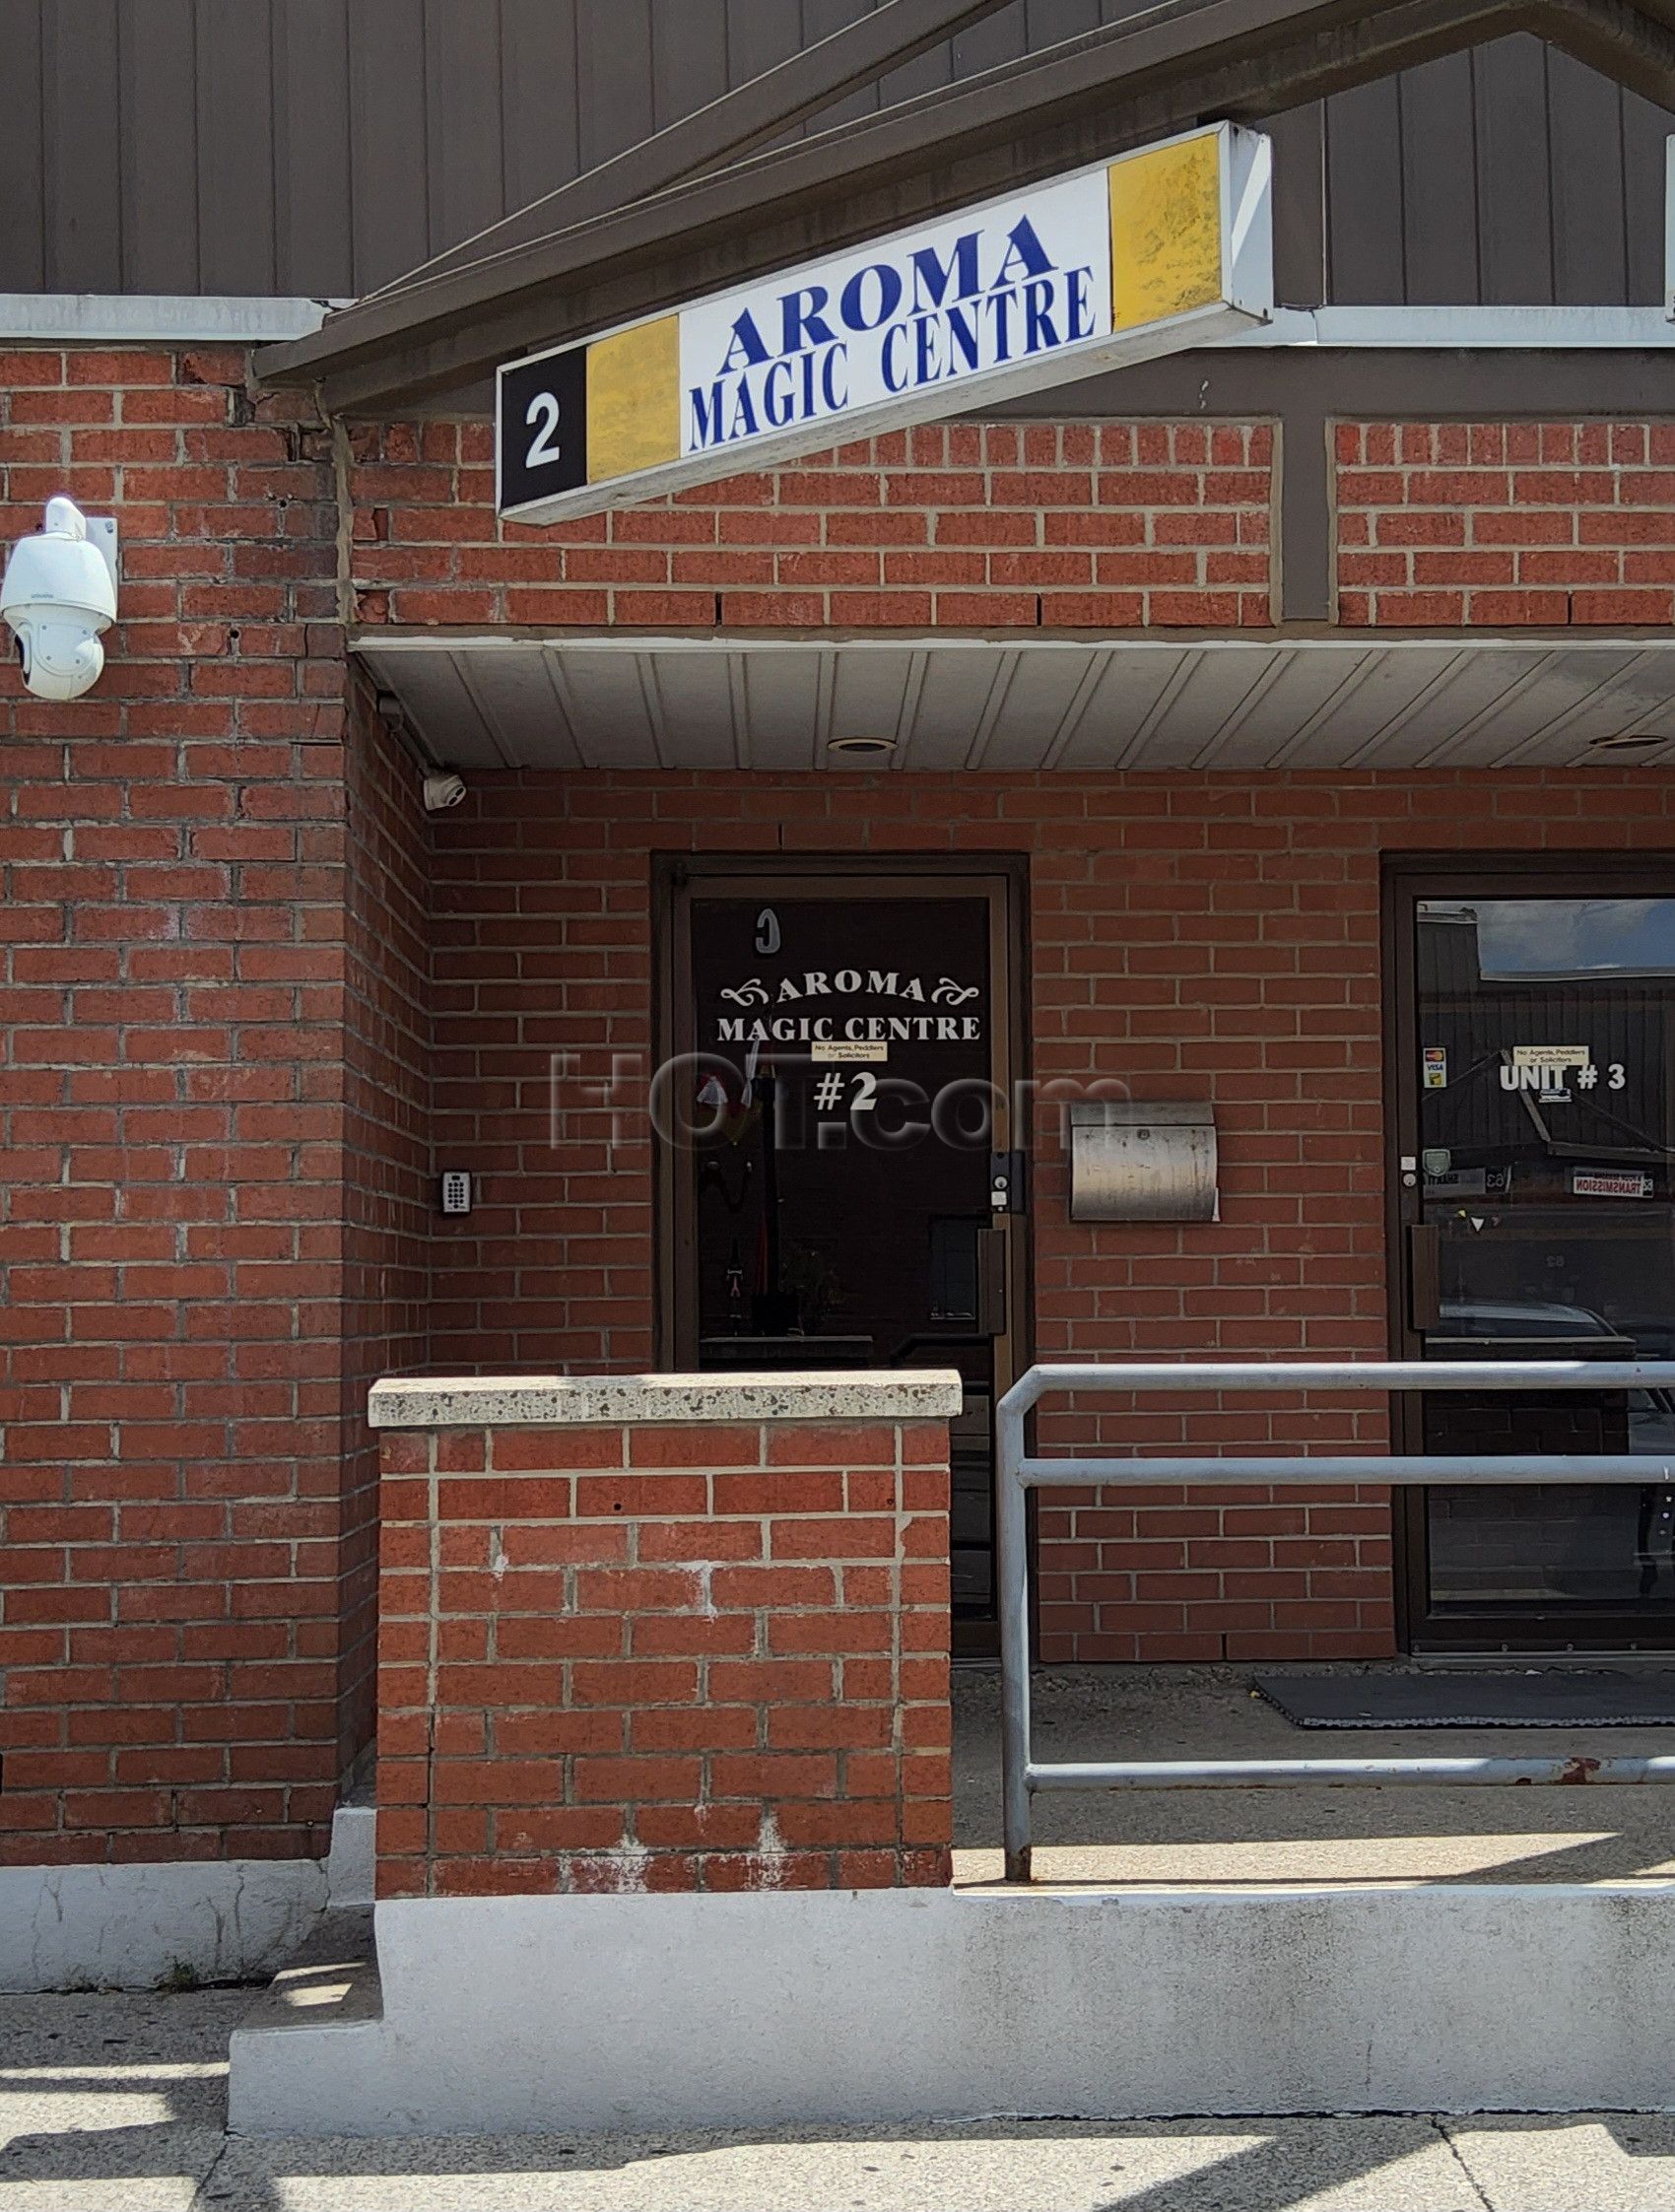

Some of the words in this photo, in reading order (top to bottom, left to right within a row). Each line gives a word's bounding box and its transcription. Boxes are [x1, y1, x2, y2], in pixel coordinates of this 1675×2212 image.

[720, 214, 1058, 375] AROMA
[688, 340, 848, 451] MAGIC
[882, 265, 1095, 393] CENTRE
[524, 392, 561, 469] 2
[776, 969, 926, 1004] AROMA
[717, 1017, 833, 1042] MAGIC
[844, 1016, 981, 1041] CENTRE
[813, 1071, 878, 1110] #2
[1500, 1064, 1567, 1090] UNIT
[1577, 1064, 1598, 1090] #
[1608, 1063, 1626, 1090] 3
